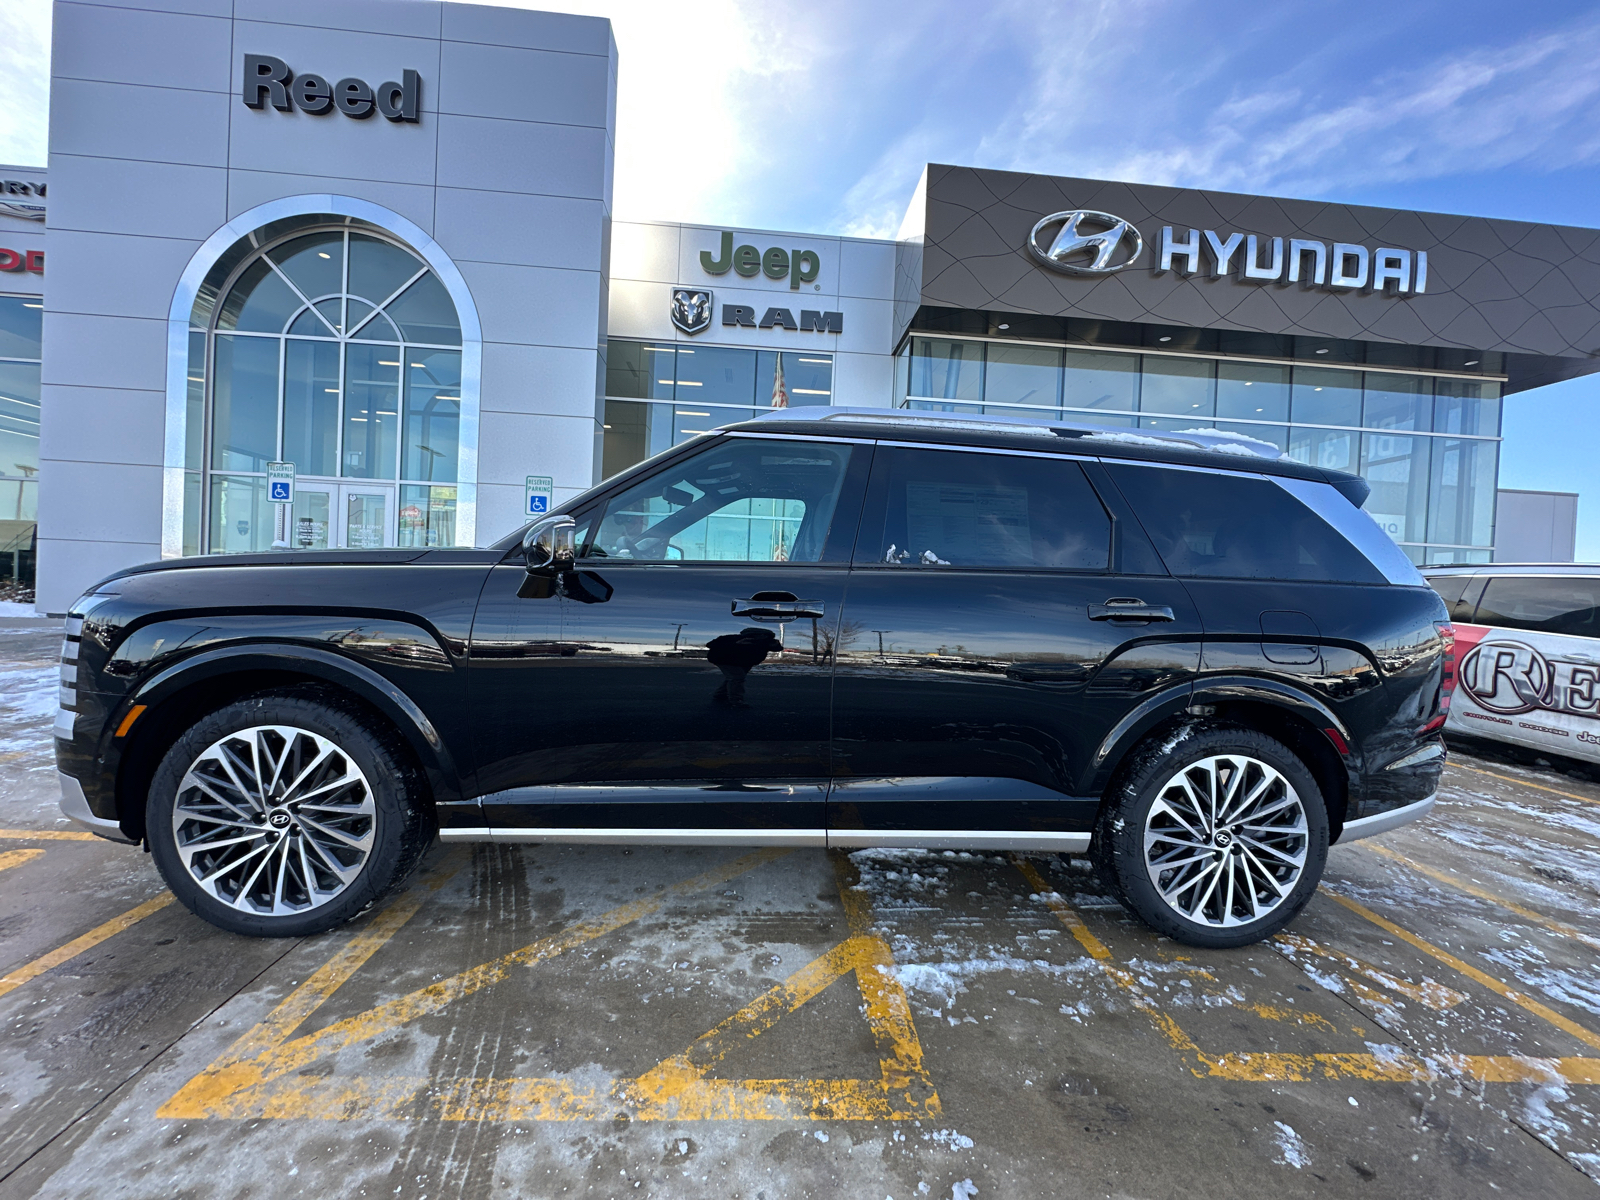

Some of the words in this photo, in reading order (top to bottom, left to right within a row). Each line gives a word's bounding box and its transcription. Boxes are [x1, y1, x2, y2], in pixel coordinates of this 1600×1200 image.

[243, 53, 421, 123] Reed
[0, 181, 47, 197] RY
[699, 231, 820, 290] Jeep
[1156, 225, 1428, 294] HYUNDAI
[722, 303, 843, 333] RAM
[1519, 722, 1569, 737] DODGE
